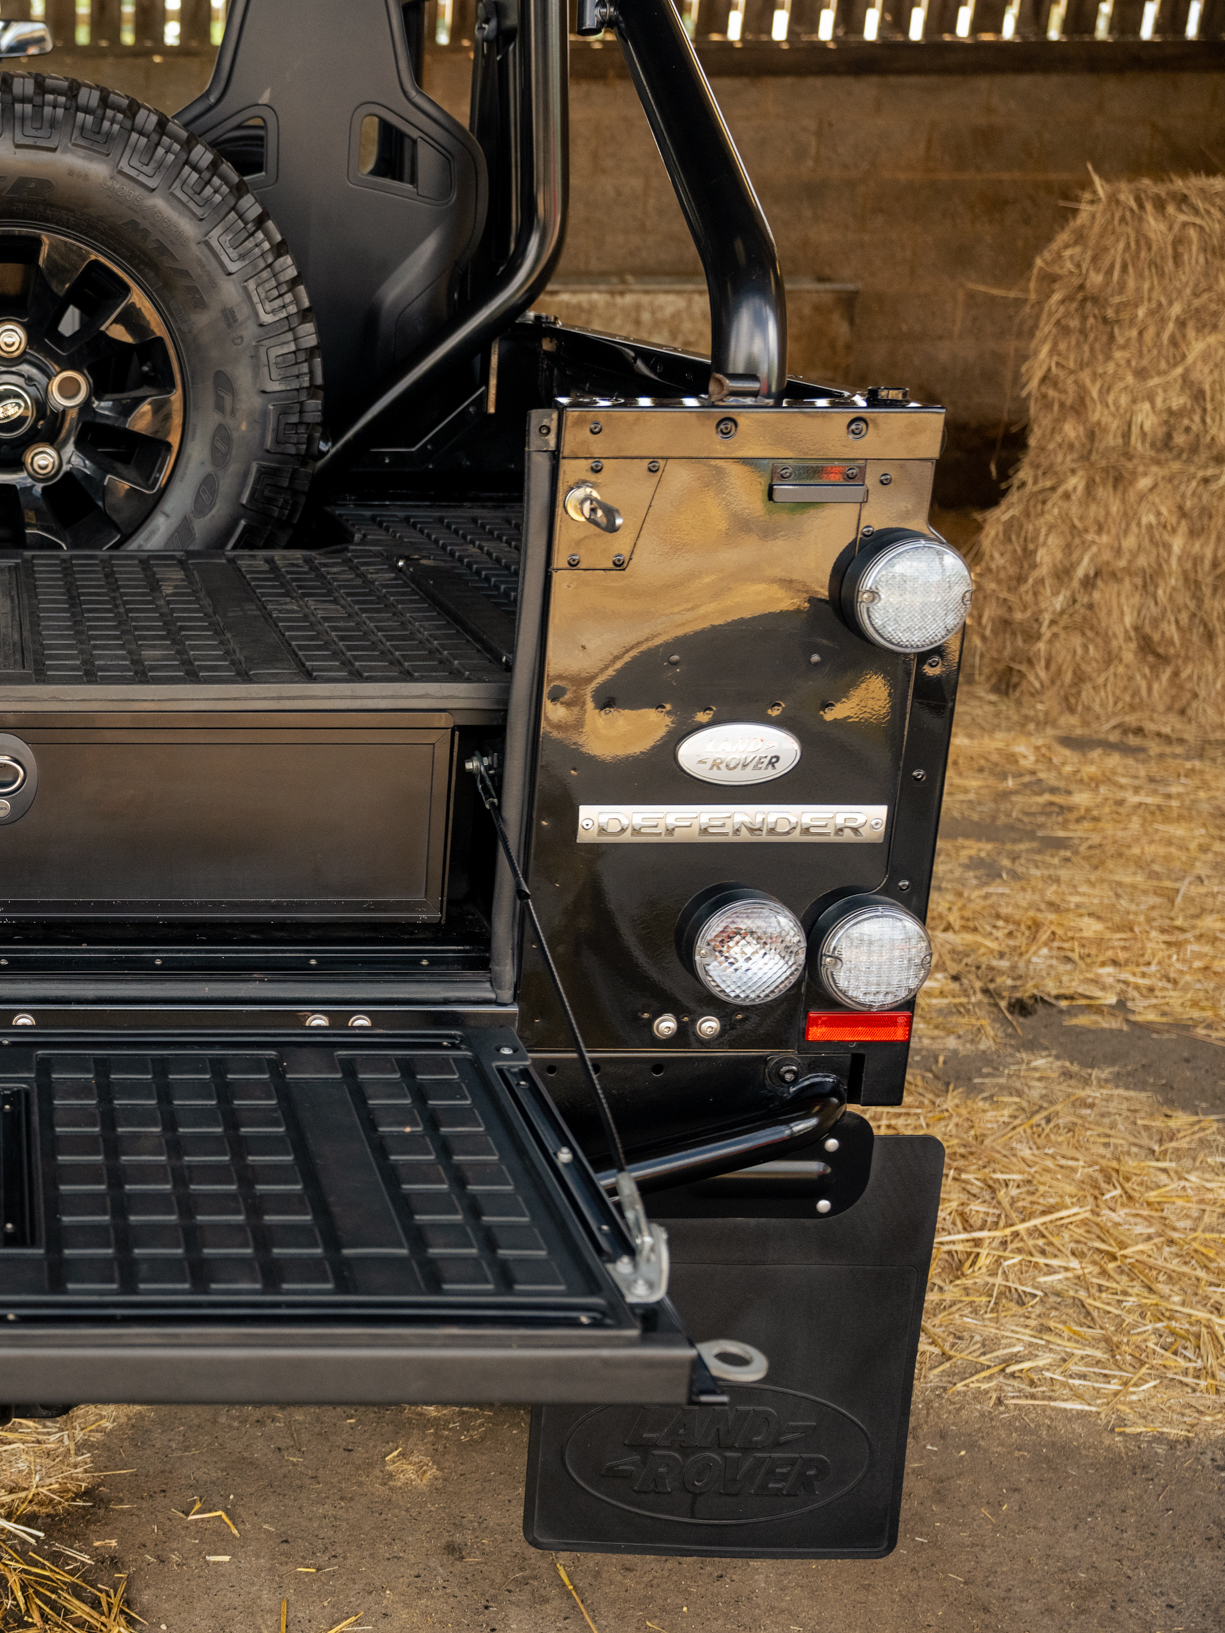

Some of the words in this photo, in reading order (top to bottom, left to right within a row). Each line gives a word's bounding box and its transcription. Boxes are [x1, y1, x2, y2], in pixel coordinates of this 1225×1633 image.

[708, 754, 781, 771] ROVER
[597, 811, 868, 838] DEFENDER
[624, 1405, 776, 1449] LAND
[633, 1451, 830, 1496] ROVER
